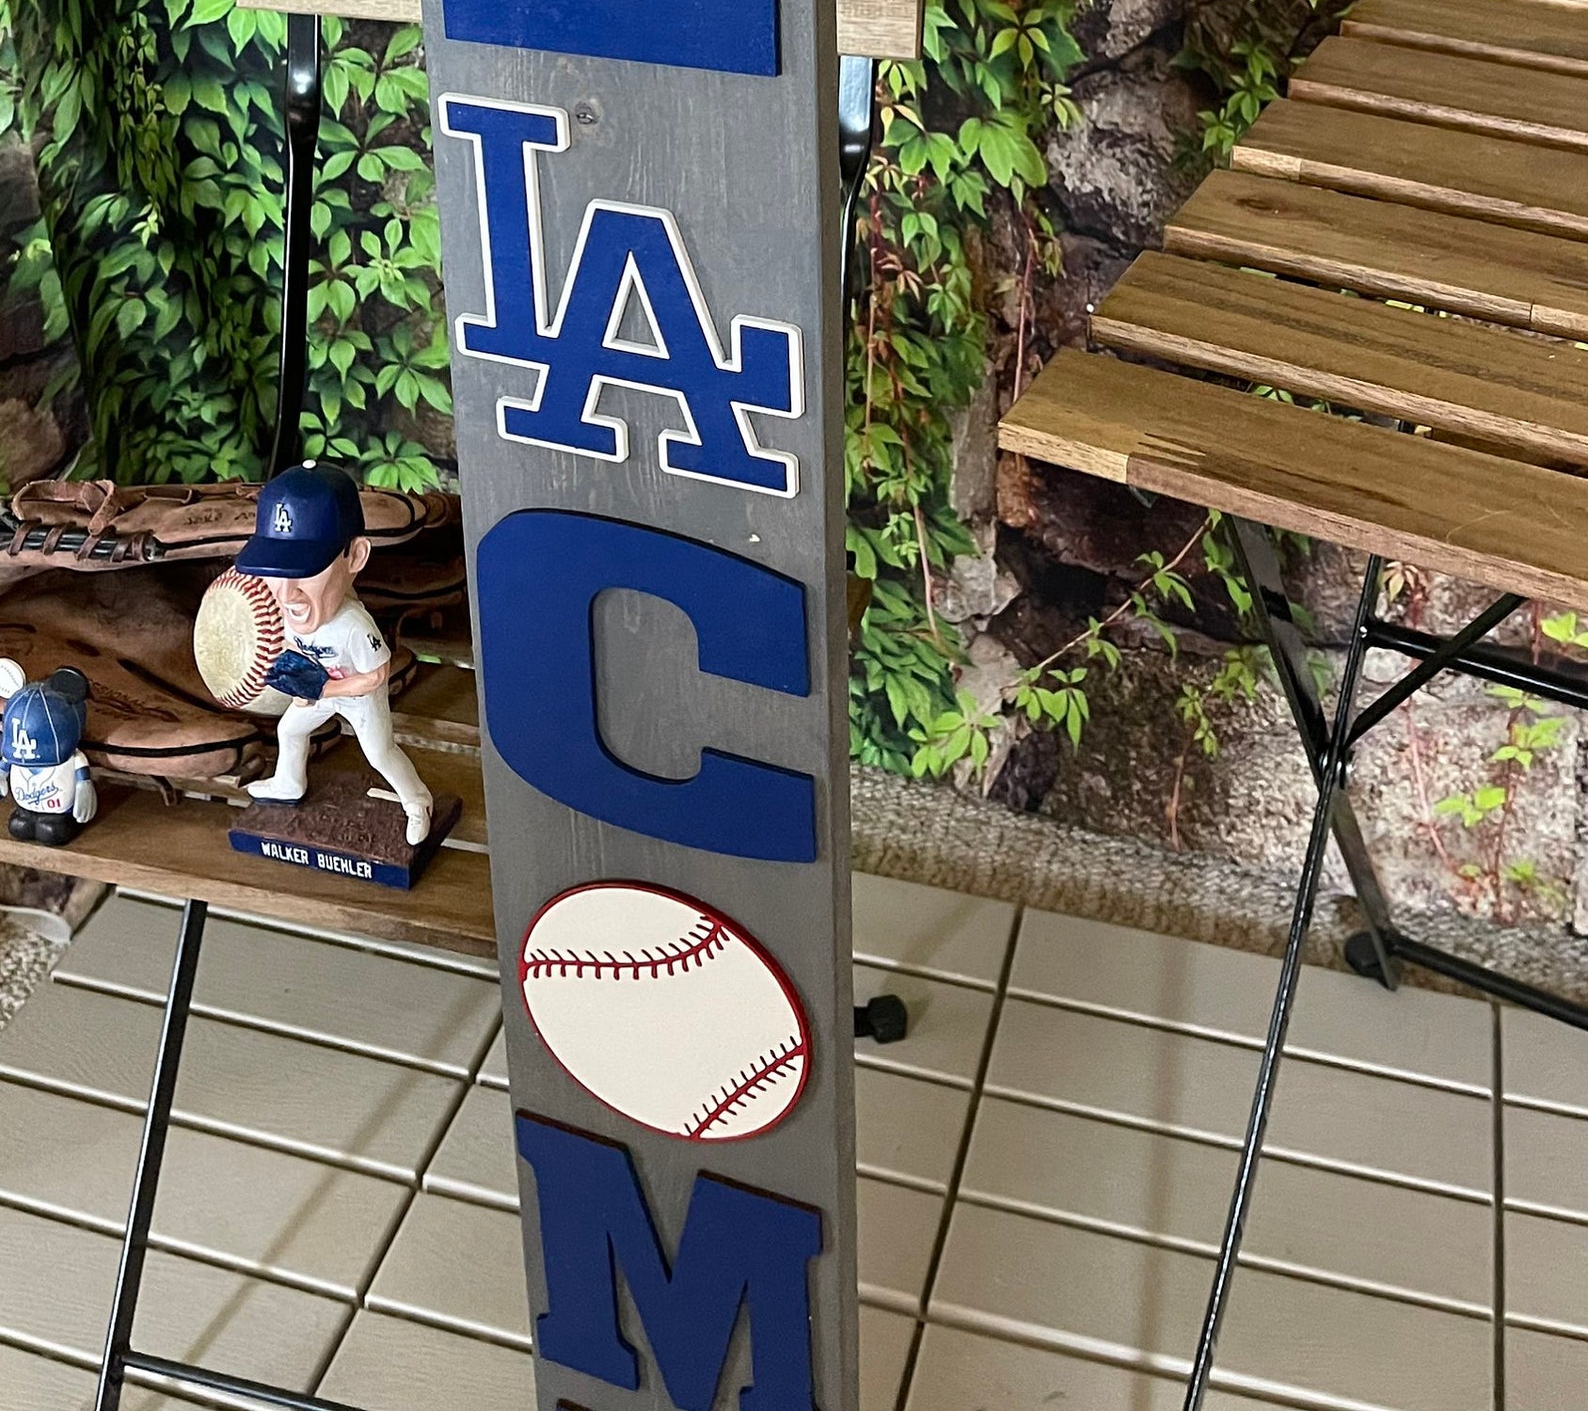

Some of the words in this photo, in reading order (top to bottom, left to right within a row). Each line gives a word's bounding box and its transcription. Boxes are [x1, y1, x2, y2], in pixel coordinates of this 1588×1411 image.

[274, 503, 292, 532] LA
[12, 718, 37, 759] LA
[15, 781, 61, 805] Dodgers
[47, 798, 61, 808] 01
[261, 842, 309, 865] WALKER
[317, 853, 372, 878] BUEHLER
